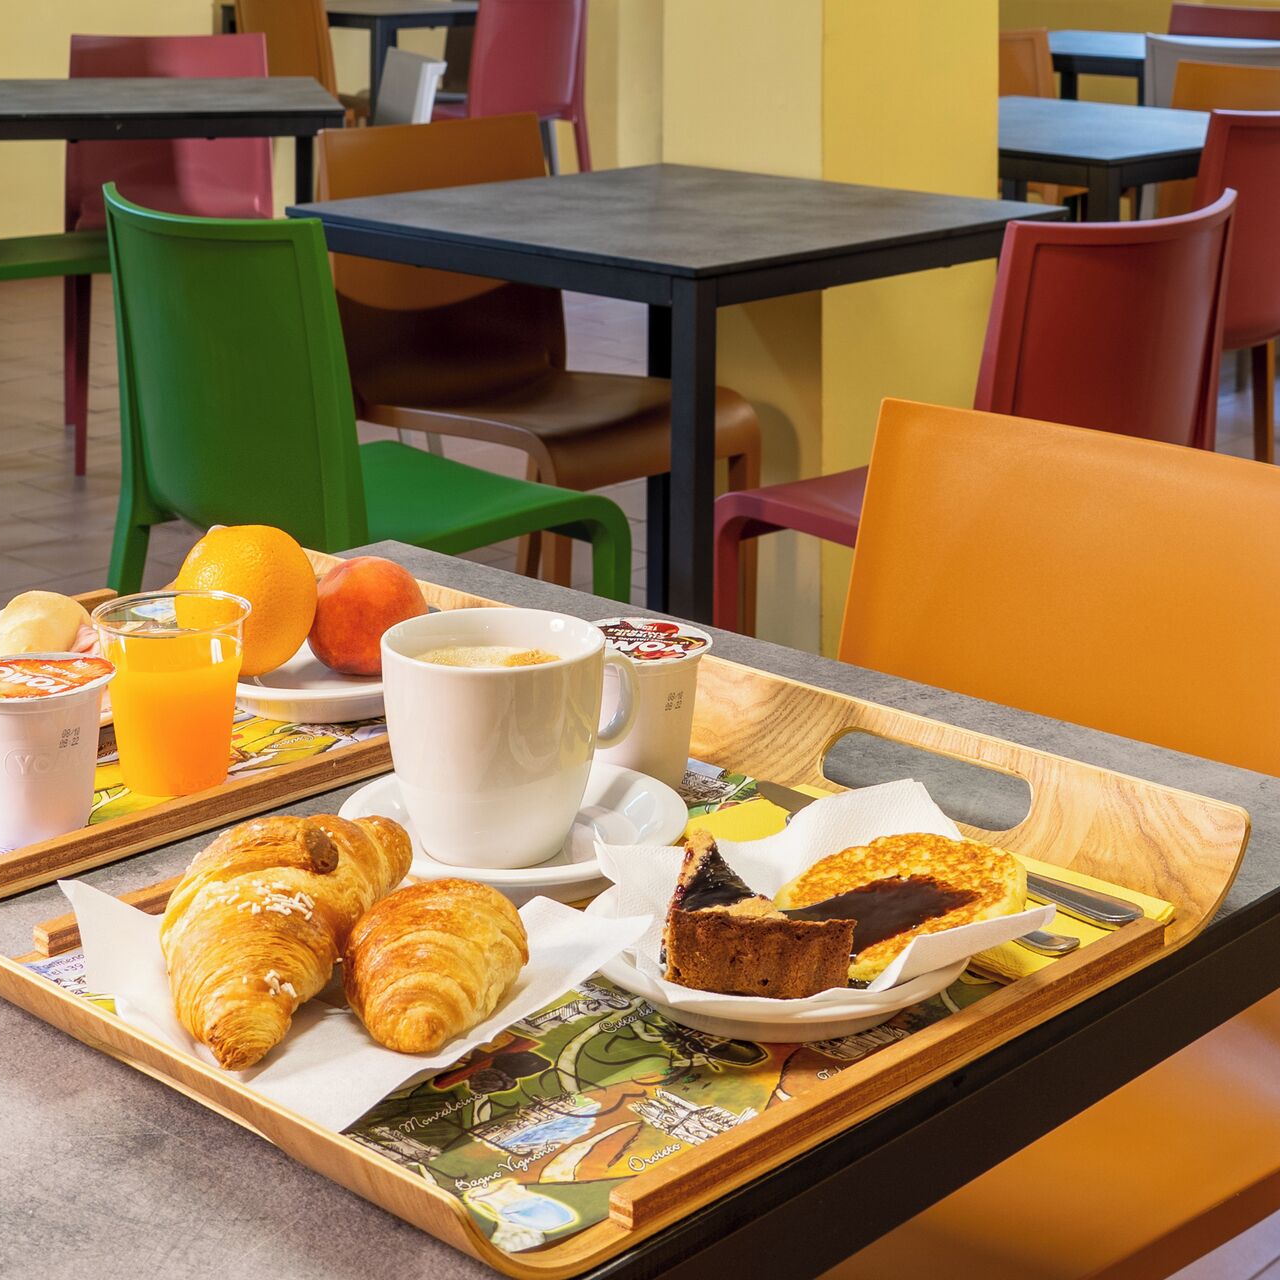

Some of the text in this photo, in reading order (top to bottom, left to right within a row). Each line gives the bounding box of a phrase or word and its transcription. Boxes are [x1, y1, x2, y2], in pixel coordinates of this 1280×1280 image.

[604, 639, 686, 653] YOM
[398, 1090, 485, 1135] Montalcino
[454, 1140, 556, 1192] Bagno Vignoni
[627, 1140, 683, 1173] Orvieto
